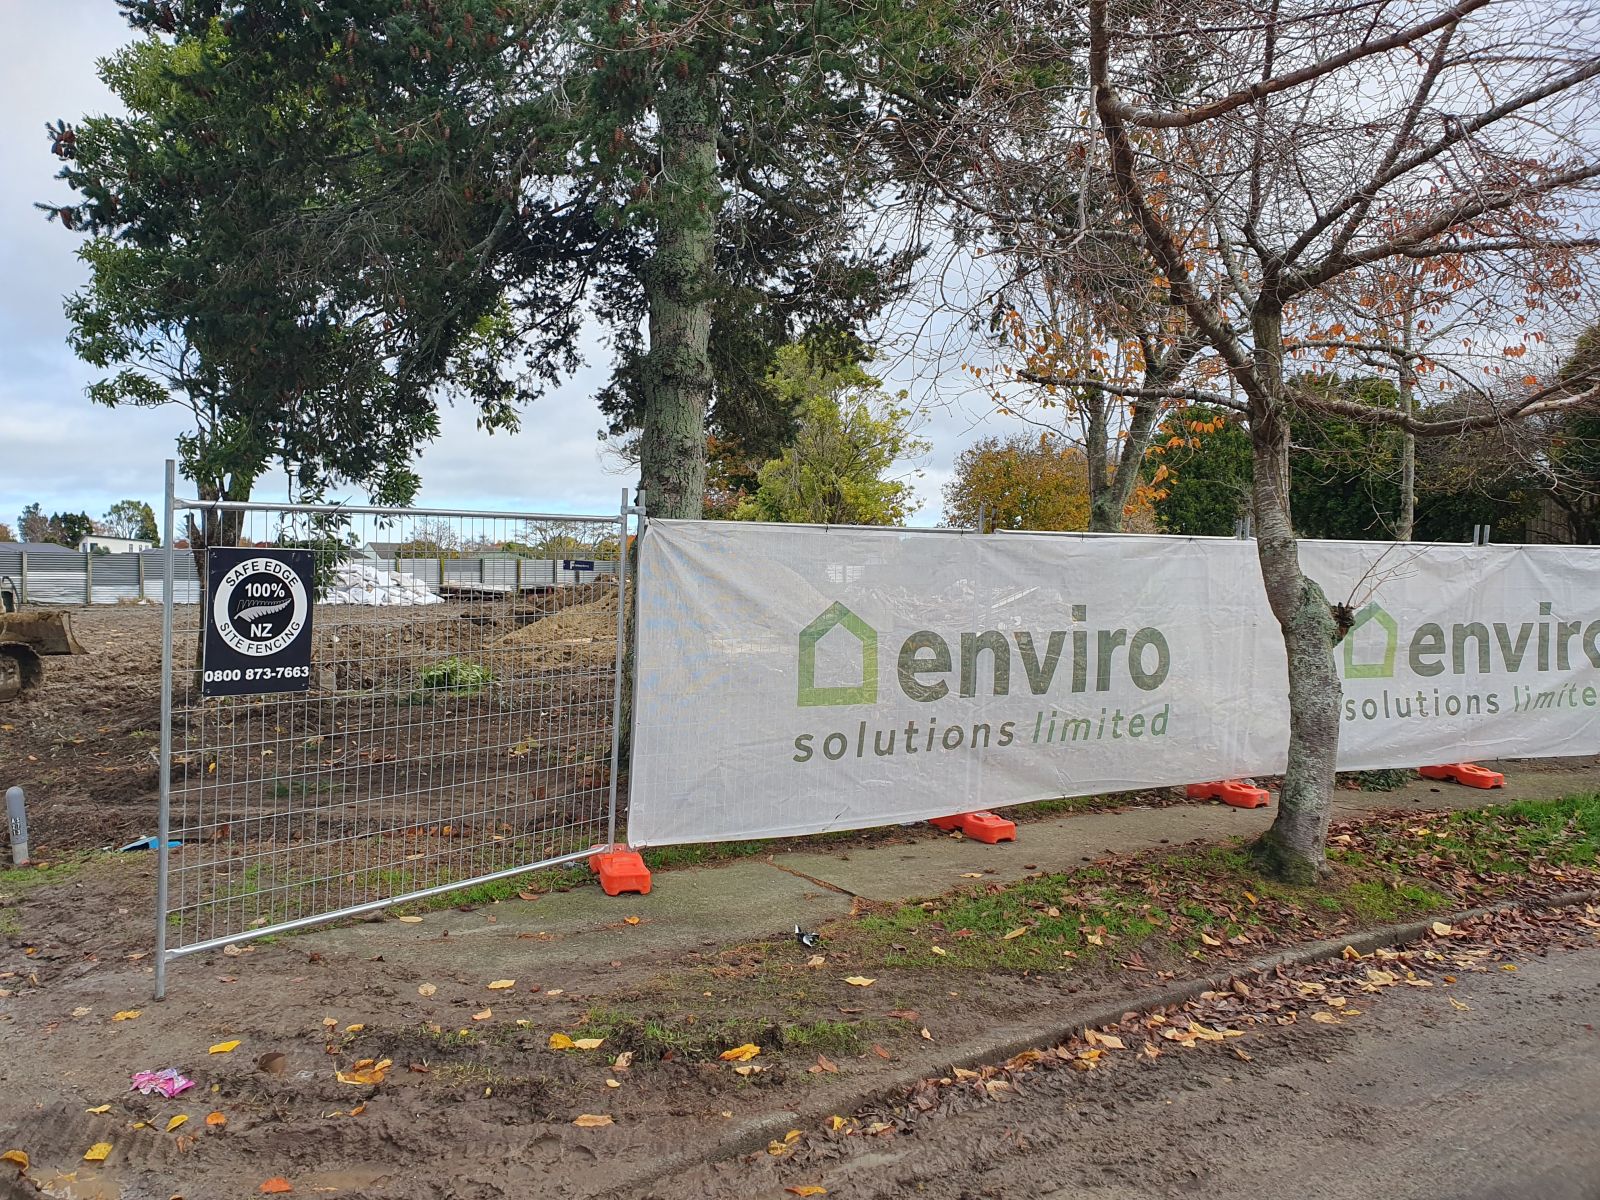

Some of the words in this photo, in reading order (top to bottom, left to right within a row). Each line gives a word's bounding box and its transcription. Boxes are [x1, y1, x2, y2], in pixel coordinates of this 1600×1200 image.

[226, 560, 260, 587] SAFE
[264, 560, 299, 588] EDGE
[244, 582, 286, 598] 100%
[220, 622, 245, 650] SITE
[246, 621, 300, 654] FENCING
[250, 623, 273, 638] NZ
[897, 604, 1171, 703] enviro
[204, 669, 242, 683] 0800
[245, 665, 310, 680] 873-7663
[1345, 687, 1500, 722] solutions
[792, 717, 1016, 763] solutions
[1032, 703, 1170, 744] limited
